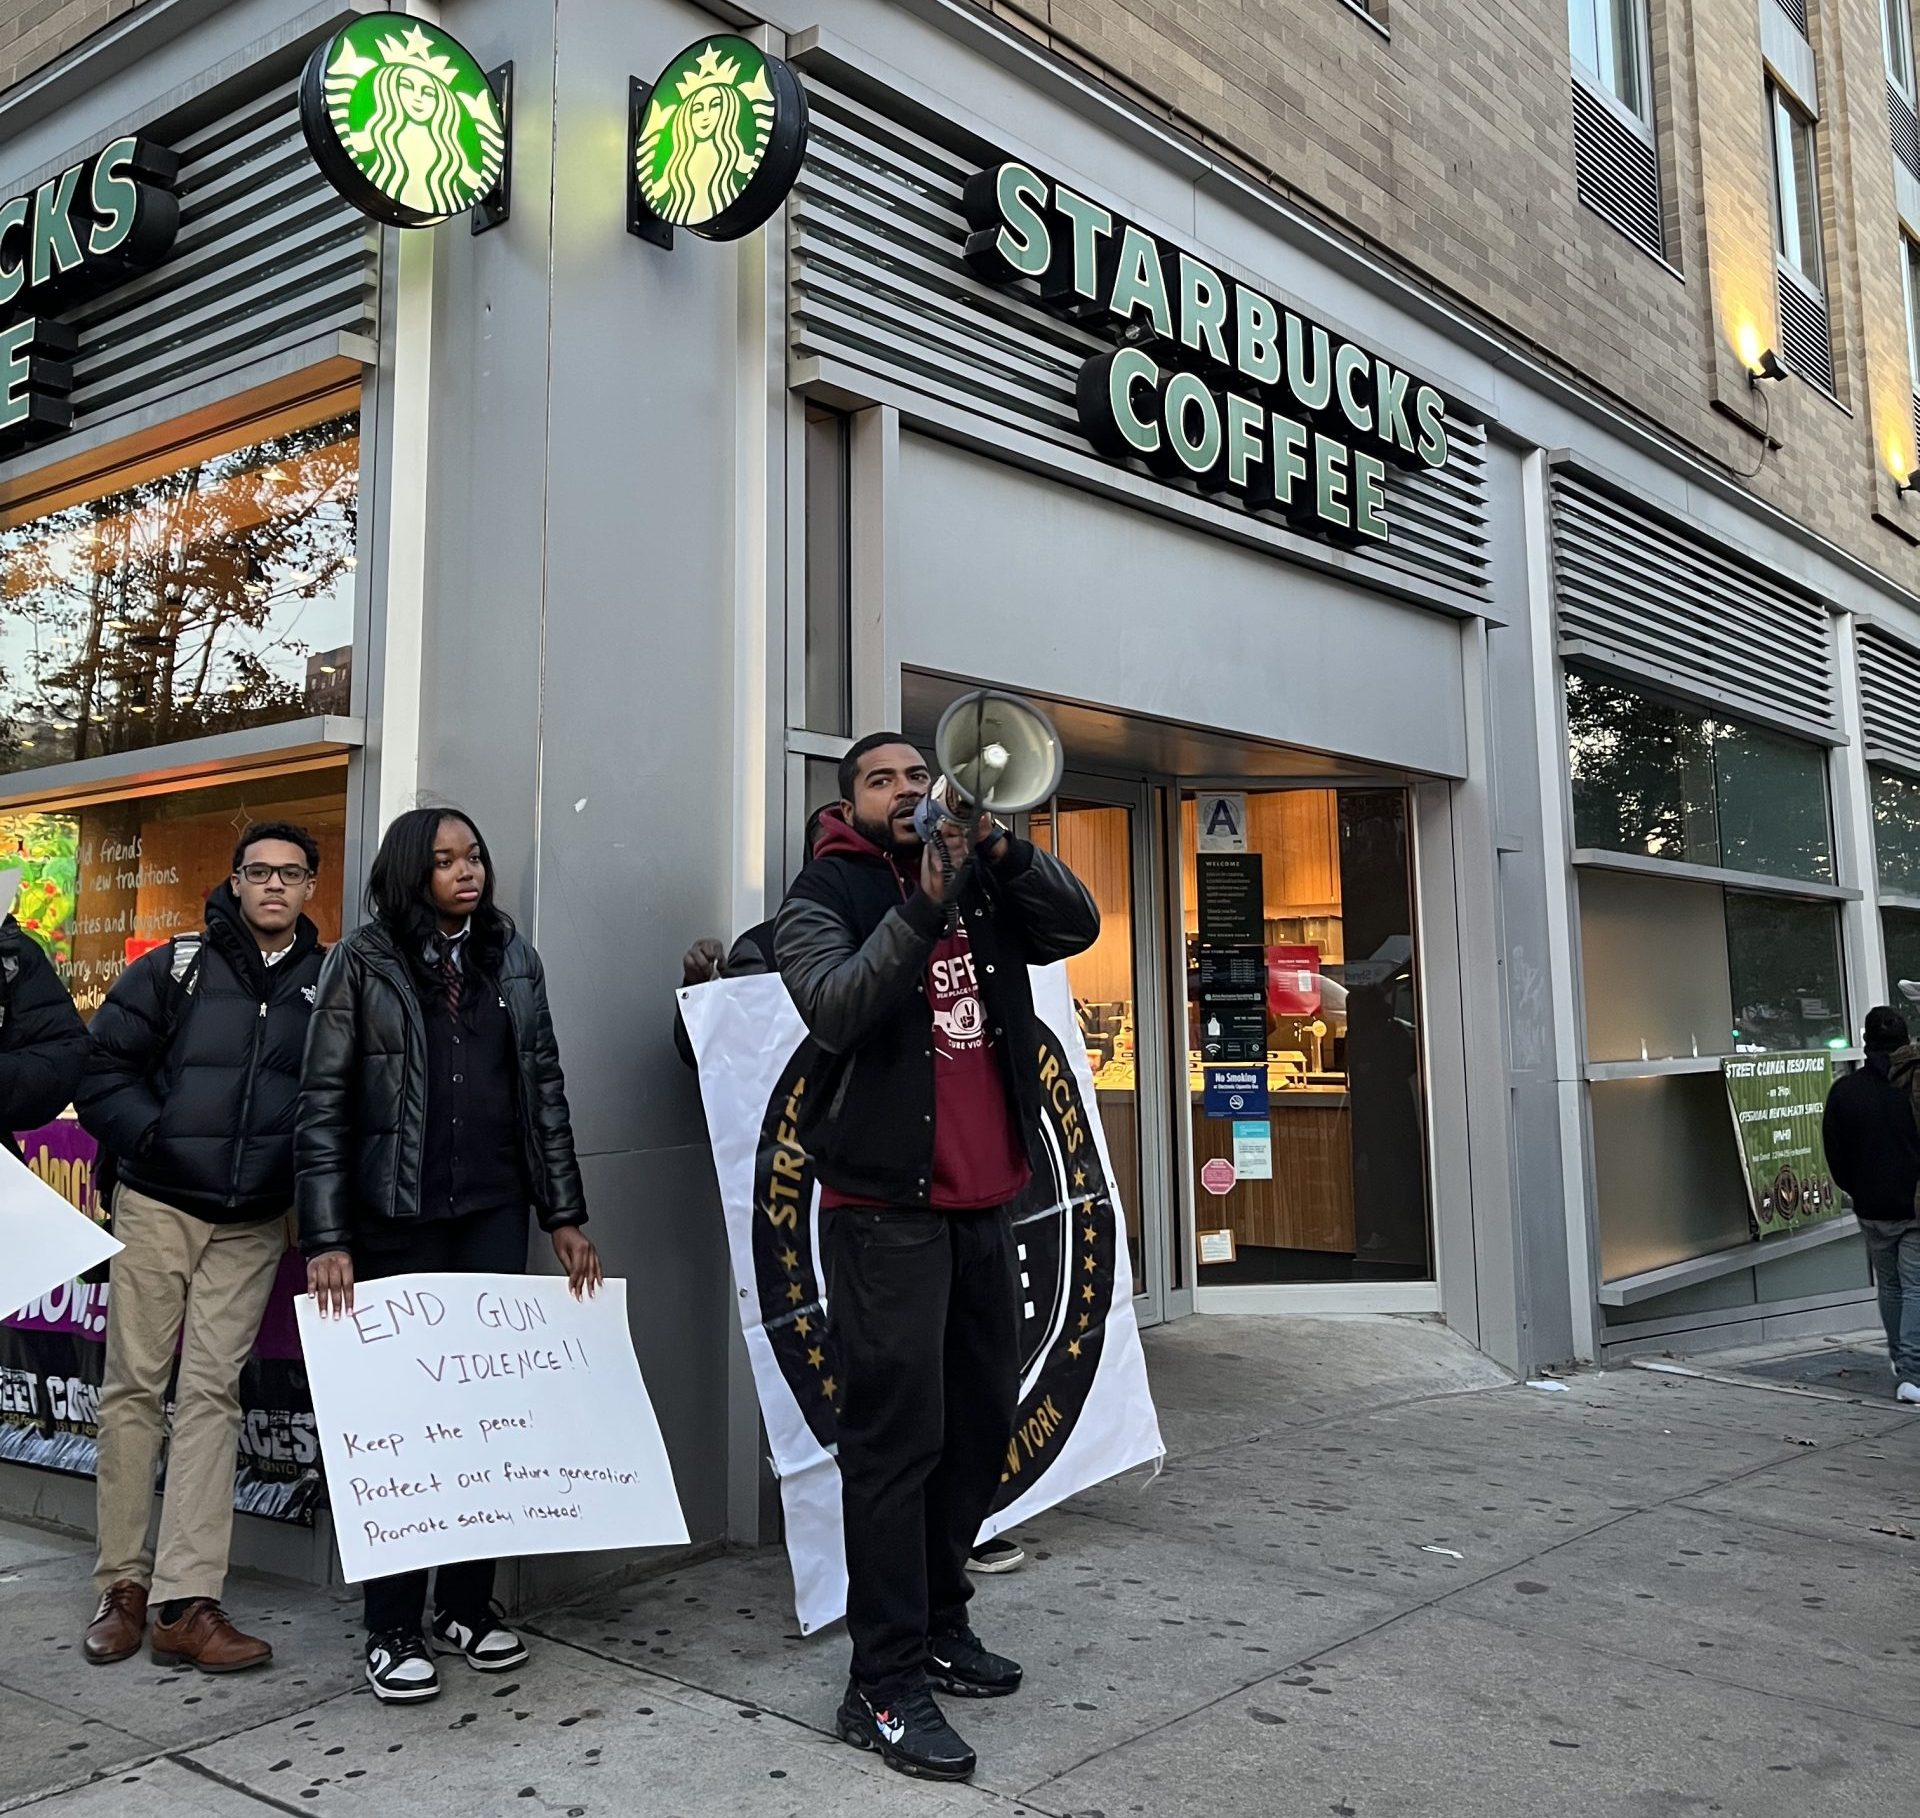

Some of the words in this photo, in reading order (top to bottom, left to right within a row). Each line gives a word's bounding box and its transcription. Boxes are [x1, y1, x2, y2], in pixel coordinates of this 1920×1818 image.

[997, 162, 1449, 469] STARBUCKS
[1108, 346, 1389, 542] COFFEE
[1206, 799, 1238, 835] A
[100, 835, 143, 863] friends
[90, 873, 112, 892] new
[115, 862, 179, 891] traditions.
[104, 908, 126, 933] and
[1215, 1072, 1225, 1083] No
[1226, 1072, 1257, 1084] Smoking
[1725, 1062, 1756, 1079] STREET
[352, 1290, 445, 1344] END
[477, 1292, 547, 1331] GUN
[416, 1338, 592, 1384] VIOLENCE!!
[343, 1433, 404, 1458] Keep
[425, 1423, 463, 1444] the
[479, 1410, 533, 1442] peace!
[1018, 1394, 1063, 1458] YORK
[350, 1473, 442, 1505] Protect
[457, 1469, 491, 1488] our
[503, 1462, 550, 1480] future
[559, 1467, 641, 1494] generation!
[364, 1519, 449, 1546] Promote
[457, 1511, 515, 1527] safety
[522, 1504, 584, 1520] instead!
